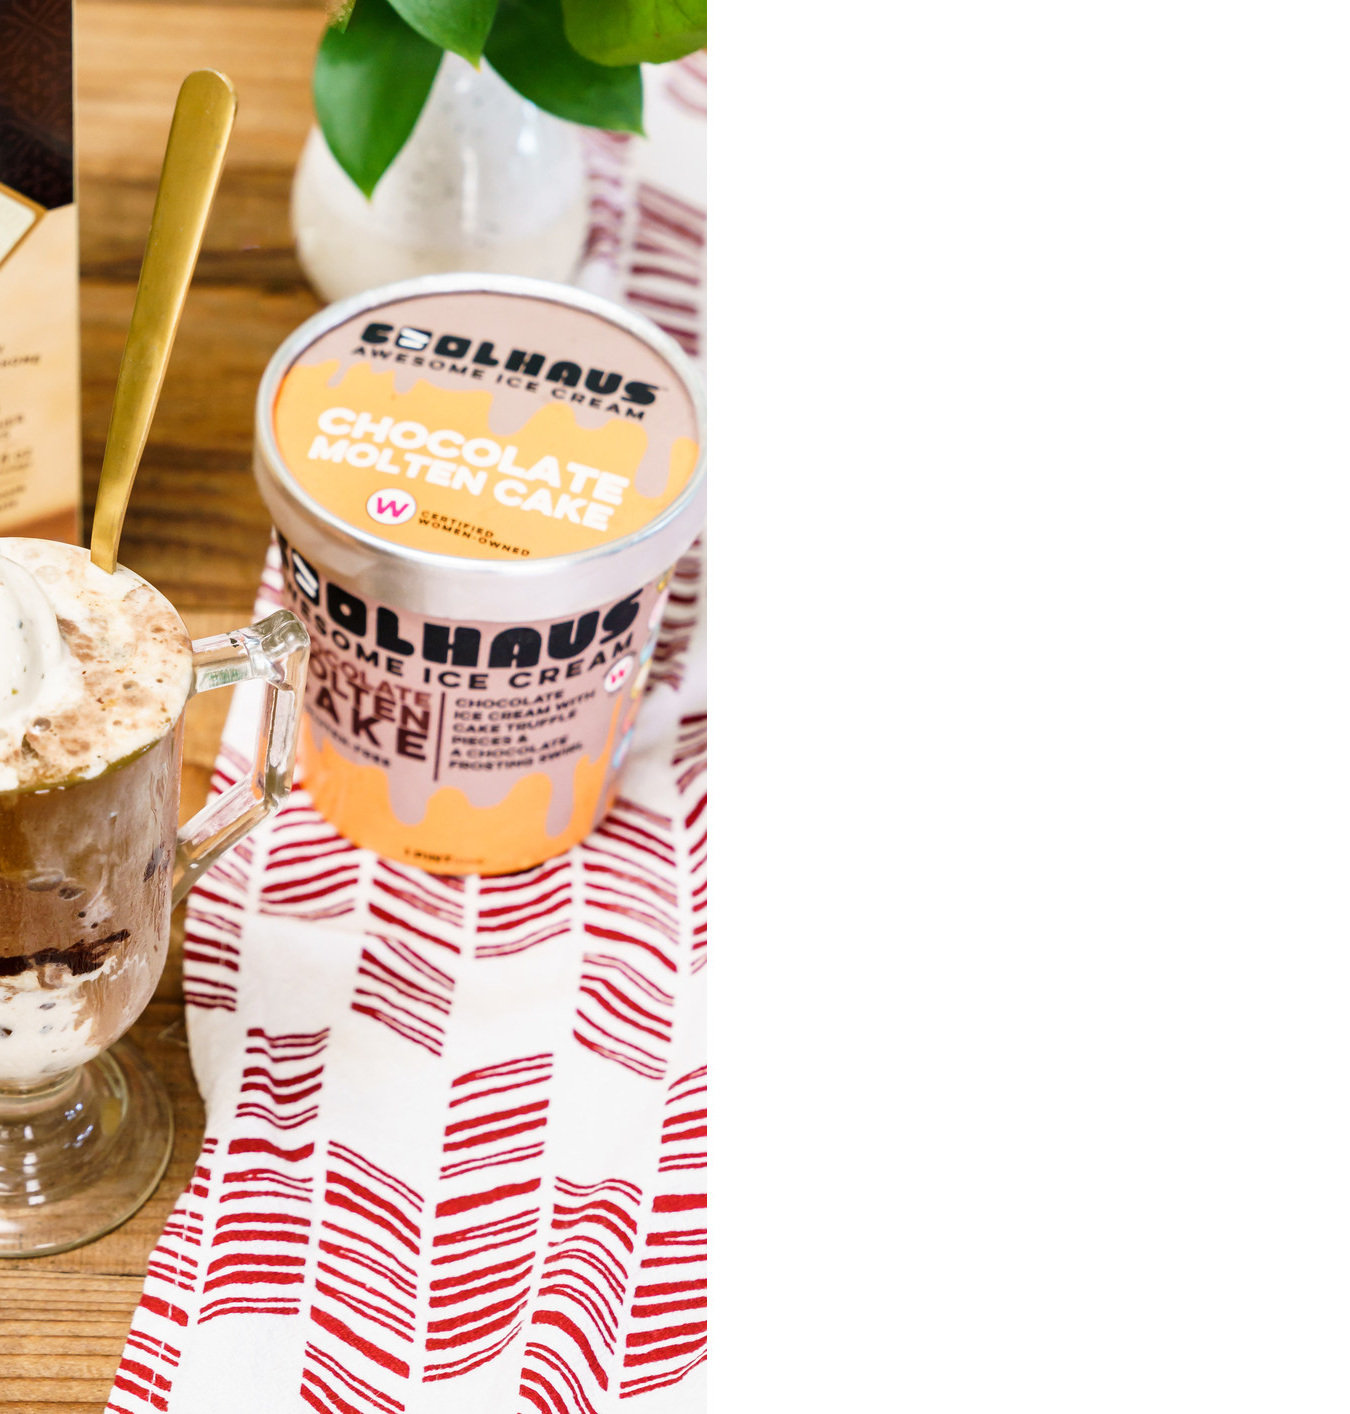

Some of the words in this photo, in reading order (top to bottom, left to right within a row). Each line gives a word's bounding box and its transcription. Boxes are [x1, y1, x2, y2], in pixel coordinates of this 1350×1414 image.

[353, 346, 484, 380] AWESOME
[496, 374, 539, 393] ICE
[551, 388, 646, 422] CREAM
[317, 407, 631, 505] CHOCOLATE
[307, 435, 489, 497] MOLTEN
[493, 479, 615, 532] CAKE
[376, 497, 410, 518] W
[421, 510, 494, 538] CERTIFIED
[419, 518, 530, 556] WOMEN-OWNED
[423, 668, 489, 690] ICE
[509, 632, 634, 689] CREAM
[310, 652, 431, 732] OLTEN
[454, 711, 483, 721] ICE
[488, 706, 551, 721] CREAM
[555, 690, 596, 711] WITH
[455, 689, 564, 708] CHOCOLATE
[305, 686, 428, 761] AKE
[453, 723, 501, 733] CAKE
[451, 736, 512, 746] PIECES
[451, 748, 461, 757] A
[466, 735, 568, 758] CHOCOLATE
